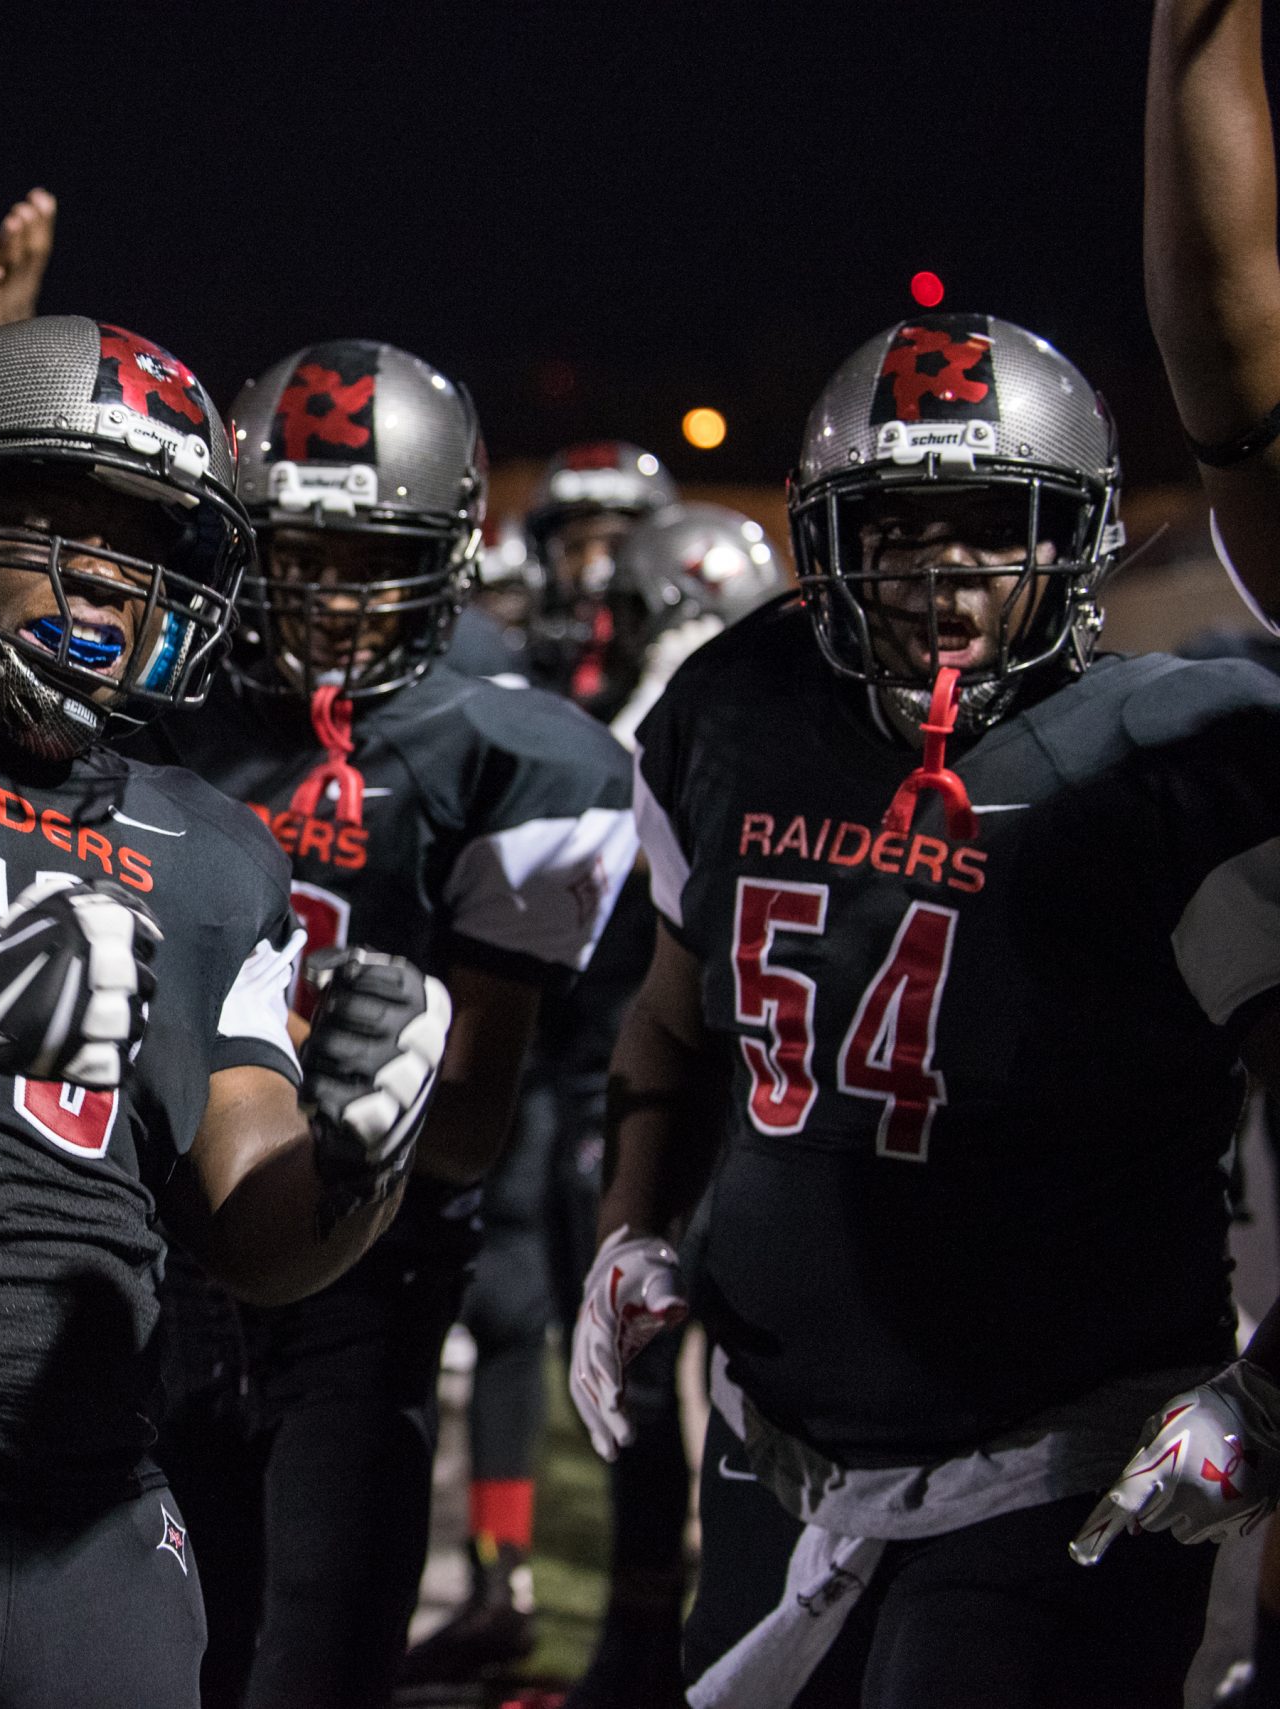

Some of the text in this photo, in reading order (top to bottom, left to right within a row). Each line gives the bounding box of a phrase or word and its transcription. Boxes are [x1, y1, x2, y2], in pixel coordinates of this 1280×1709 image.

[910, 431, 959, 447] schutt
[739, 812, 988, 893] RAIDERS
[731, 876, 959, 1162] 54
